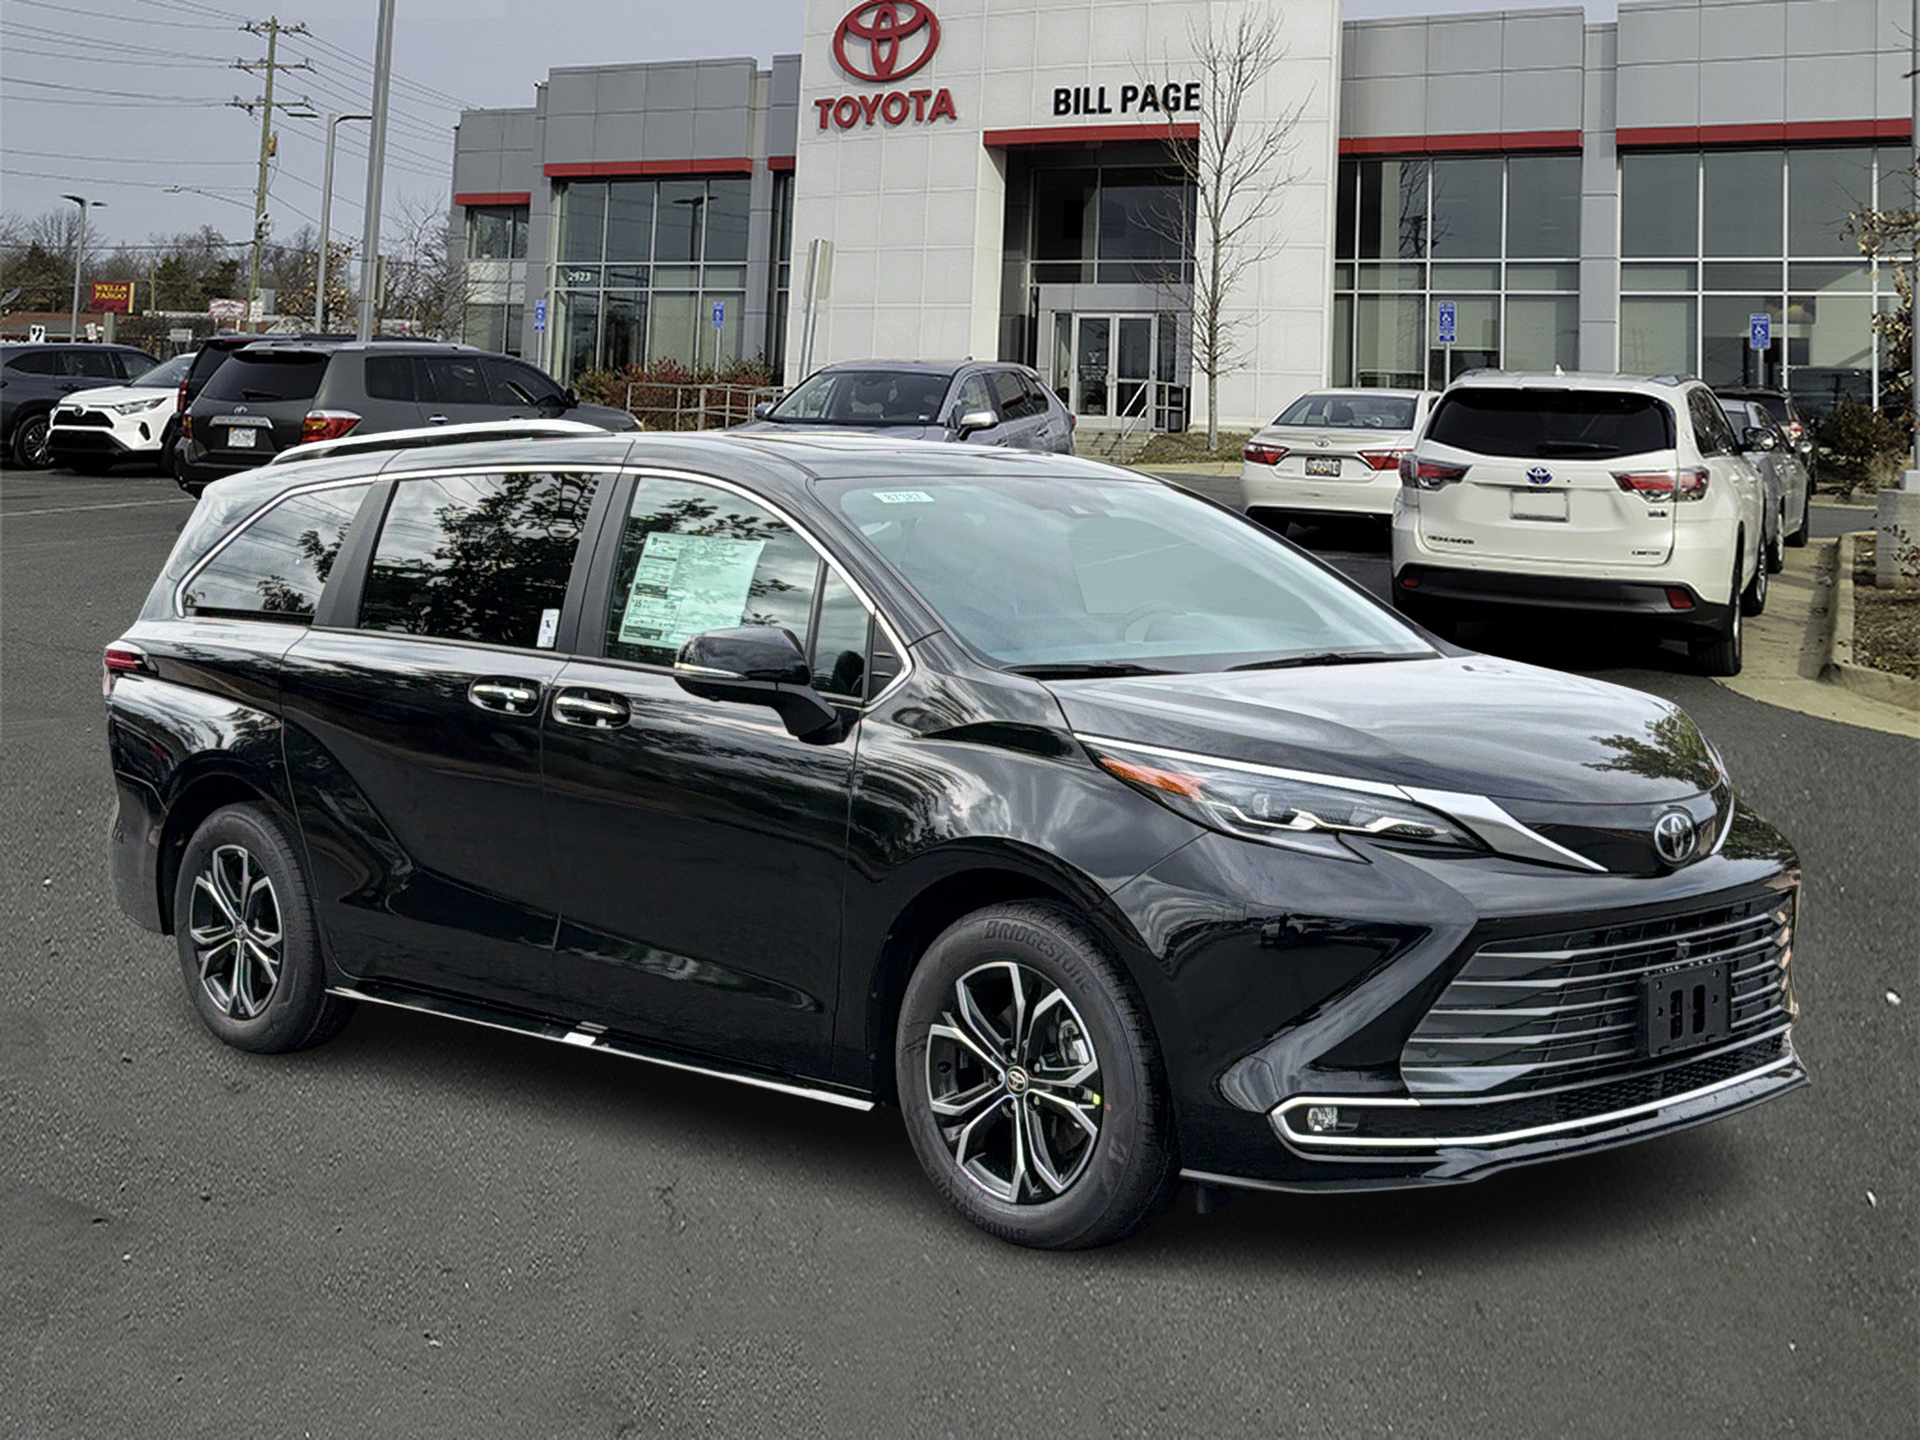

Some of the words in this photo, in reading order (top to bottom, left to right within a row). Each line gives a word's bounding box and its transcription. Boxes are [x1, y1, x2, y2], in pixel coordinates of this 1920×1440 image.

[814, 88, 958, 129] TOYOTA
[1053, 86, 1112, 116] BILL
[1121, 82, 1201, 113] PAGE
[94, 283, 127, 291] WELLS
[984, 920, 1091, 996] BRIDGESTONE
